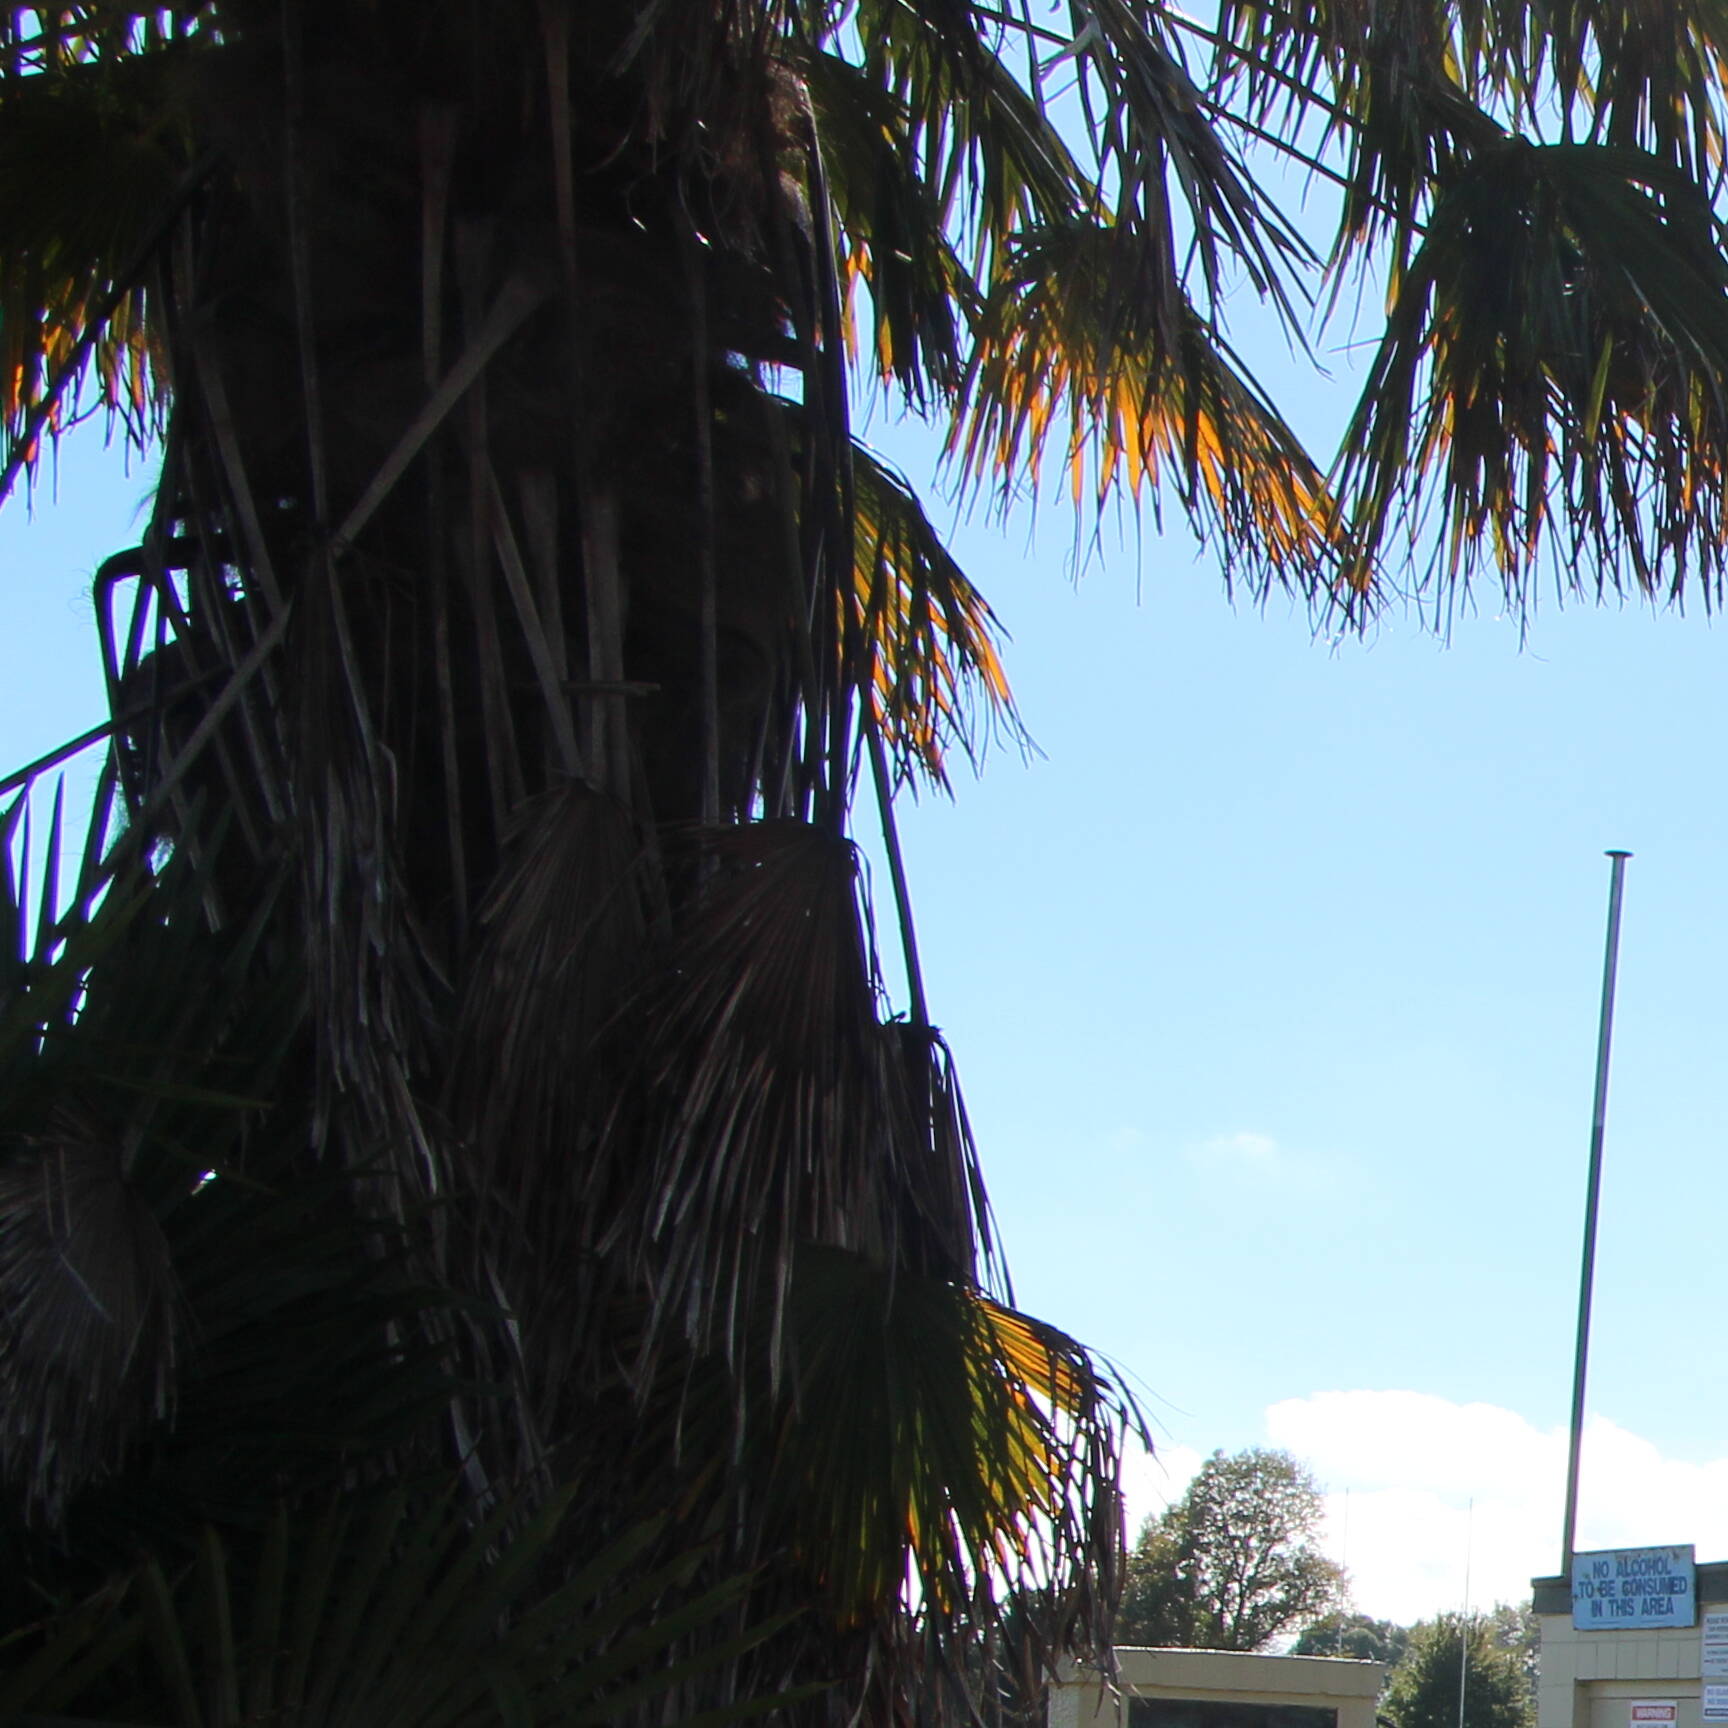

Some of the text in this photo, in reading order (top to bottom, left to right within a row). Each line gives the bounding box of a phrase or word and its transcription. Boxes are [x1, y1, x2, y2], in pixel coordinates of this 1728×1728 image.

[1593, 1556, 1672, 1579] NO ALCOHOL
[1578, 1575, 1687, 1599] TO BE CONSUMED
[1591, 1596, 1674, 1618] IN THIS AREA
